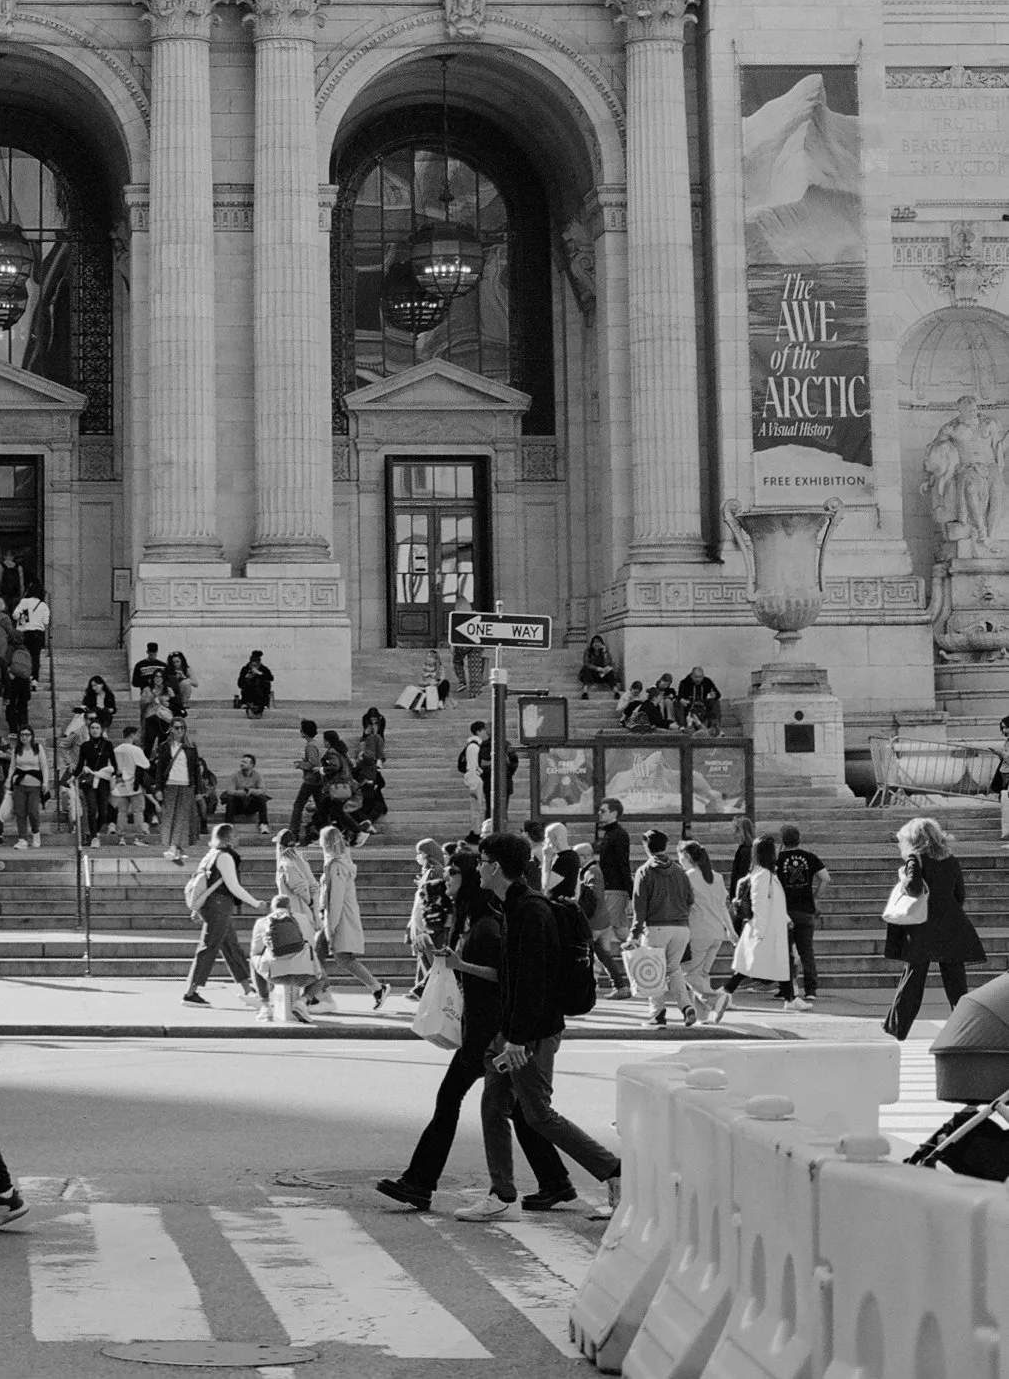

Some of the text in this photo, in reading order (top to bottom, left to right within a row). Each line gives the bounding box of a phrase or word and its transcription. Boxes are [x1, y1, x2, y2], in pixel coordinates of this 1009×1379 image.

[933, 117, 986, 131] TRUTH
[901, 138, 971, 153] BEARETH
[910, 160, 941, 174] THE
[783, 272, 814, 300] The
[775, 301, 838, 342] AWE
[770, 343, 821, 376] of the
[762, 375, 867, 418] ARCTIC
[757, 422, 834, 440] A Visual History
[763, 476, 866, 487] FREE EXHIBITION
[466, 623, 539, 639] ONE WAY
